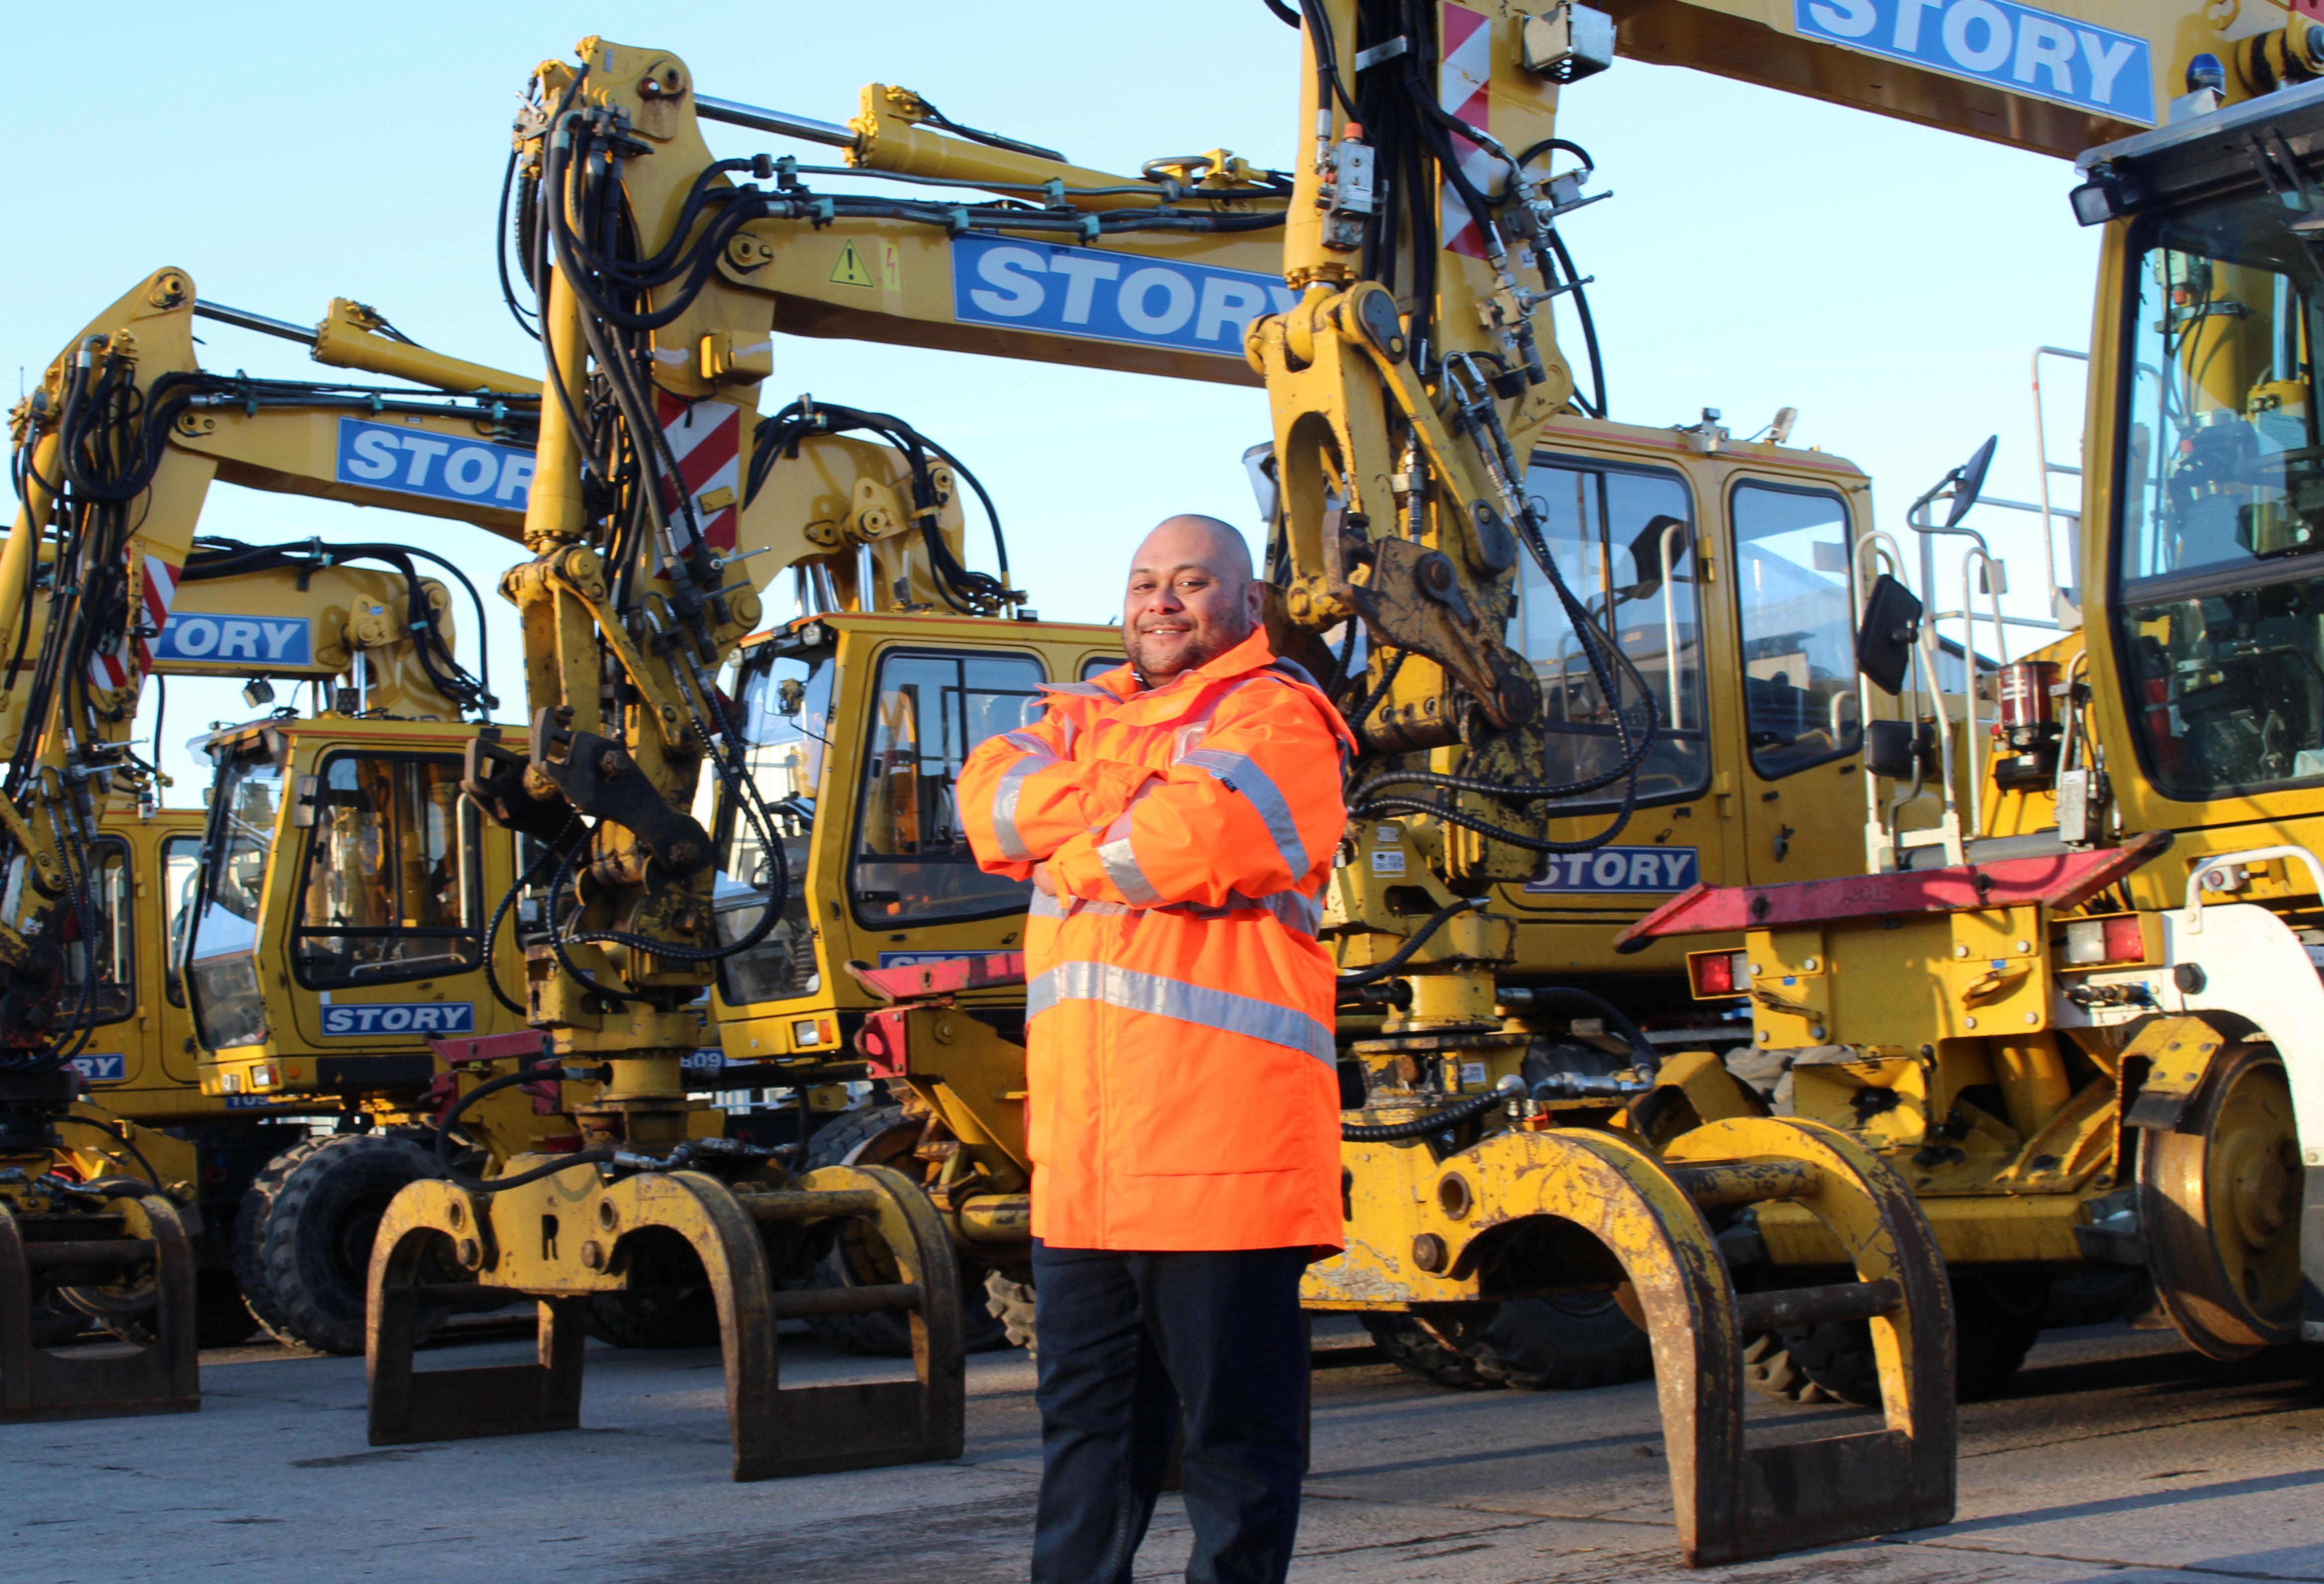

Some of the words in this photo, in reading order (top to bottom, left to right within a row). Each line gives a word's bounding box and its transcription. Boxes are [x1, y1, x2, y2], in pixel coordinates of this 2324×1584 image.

[347, 429, 537, 502] STOR
[165, 617, 301, 659] ORY
[326, 1006, 468, 1032] STORY
